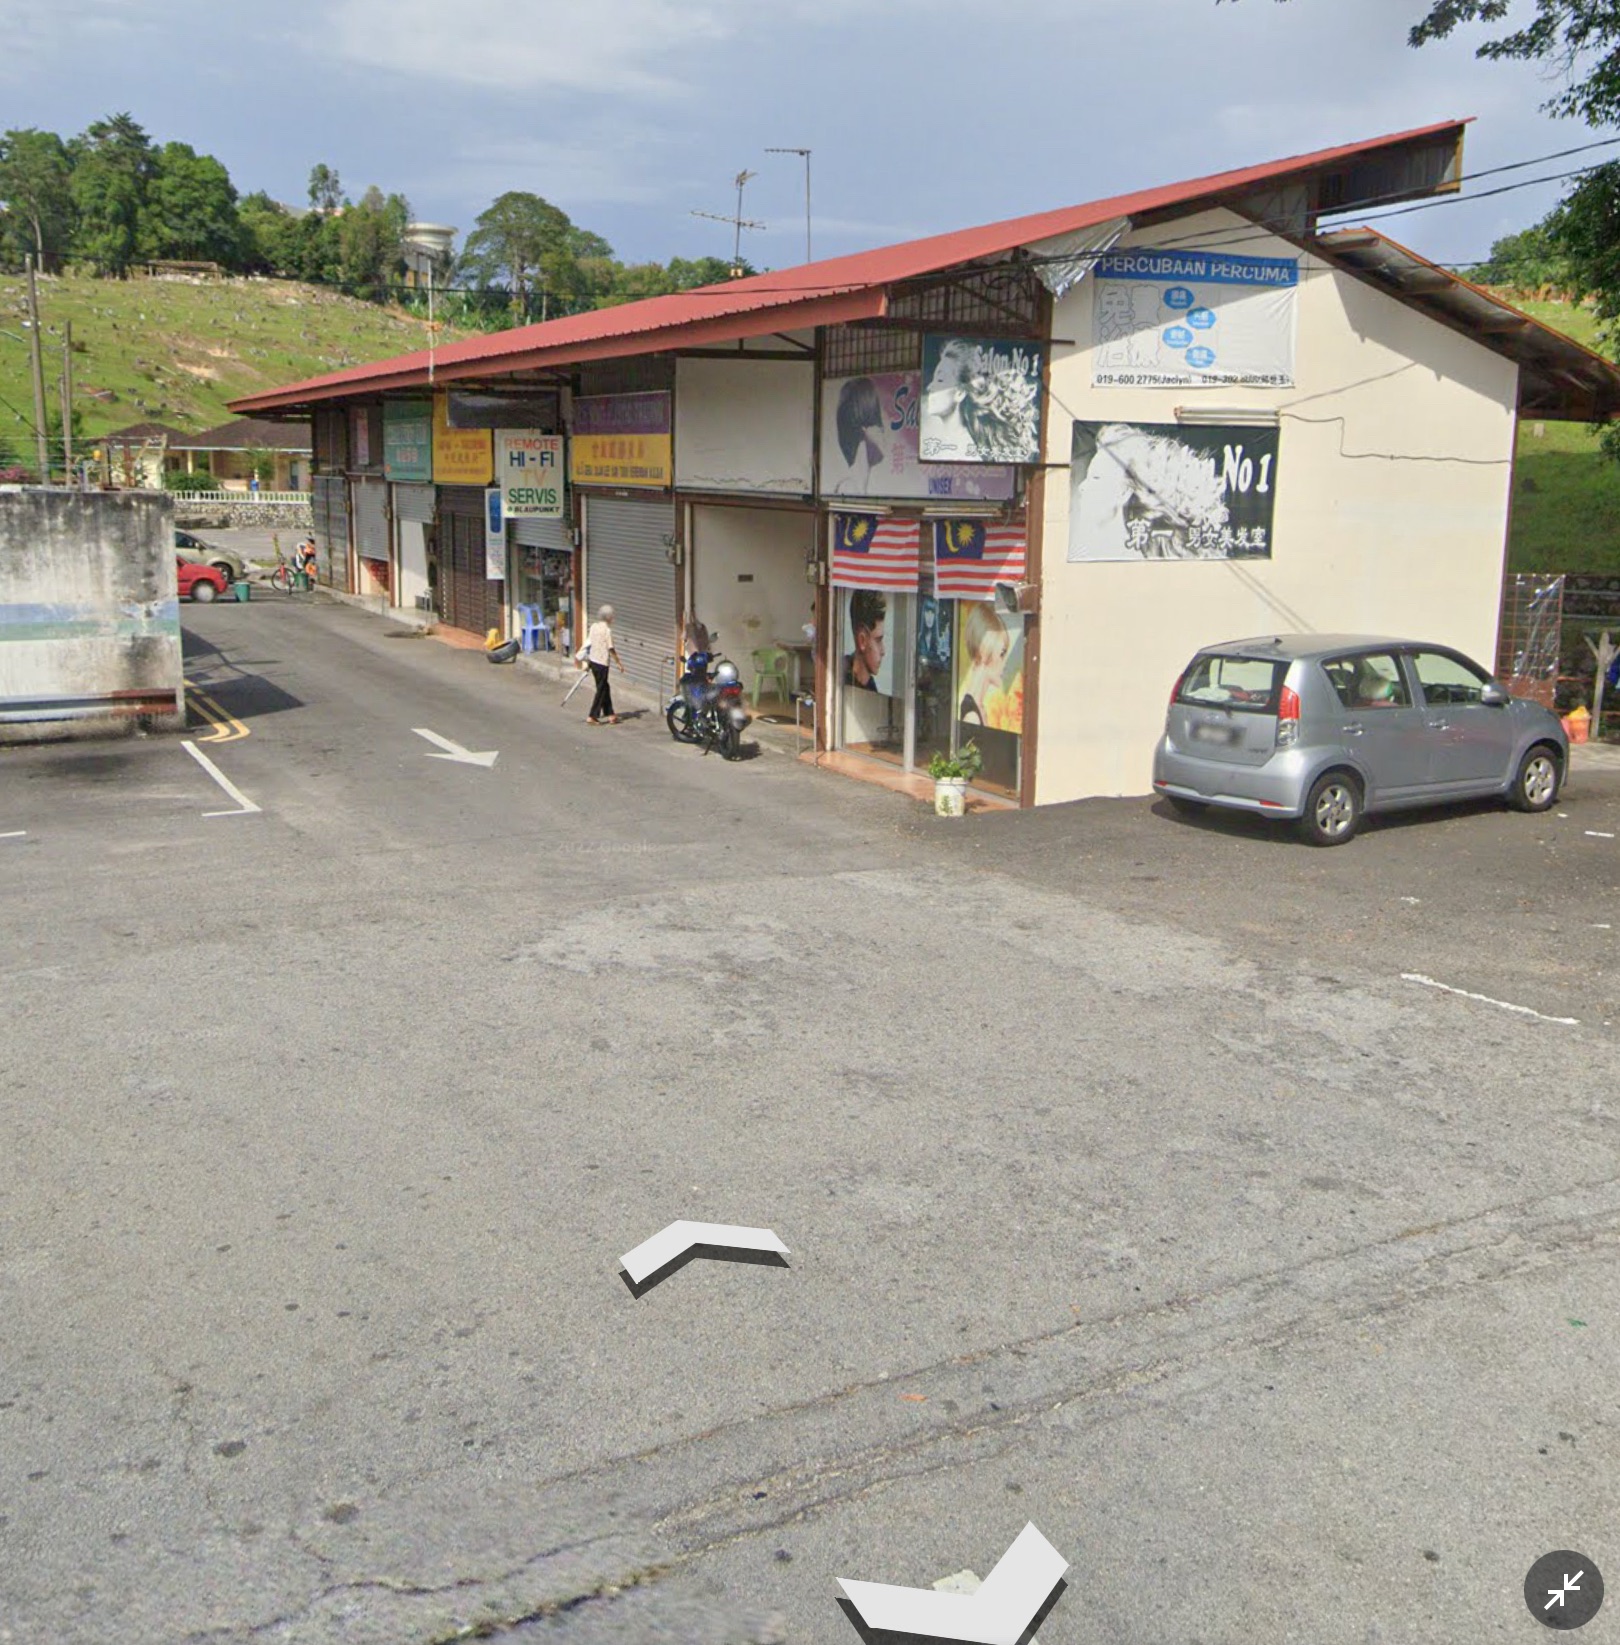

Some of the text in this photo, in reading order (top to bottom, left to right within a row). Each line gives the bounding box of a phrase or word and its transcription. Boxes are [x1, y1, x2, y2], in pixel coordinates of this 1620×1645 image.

[1101, 256, 1290, 282] PERCUBAAN PERCUMA
[975, 345, 1010, 374] Salon
[1096, 374, 1135, 385] 019-600
[504, 437, 559, 451] REMOTE
[519, 468, 547, 487] TV
[508, 487, 557, 505] SERVIS
[513, 505, 561, 514] BLAUPUNKT
[1125, 517, 1174, 551] 第一
